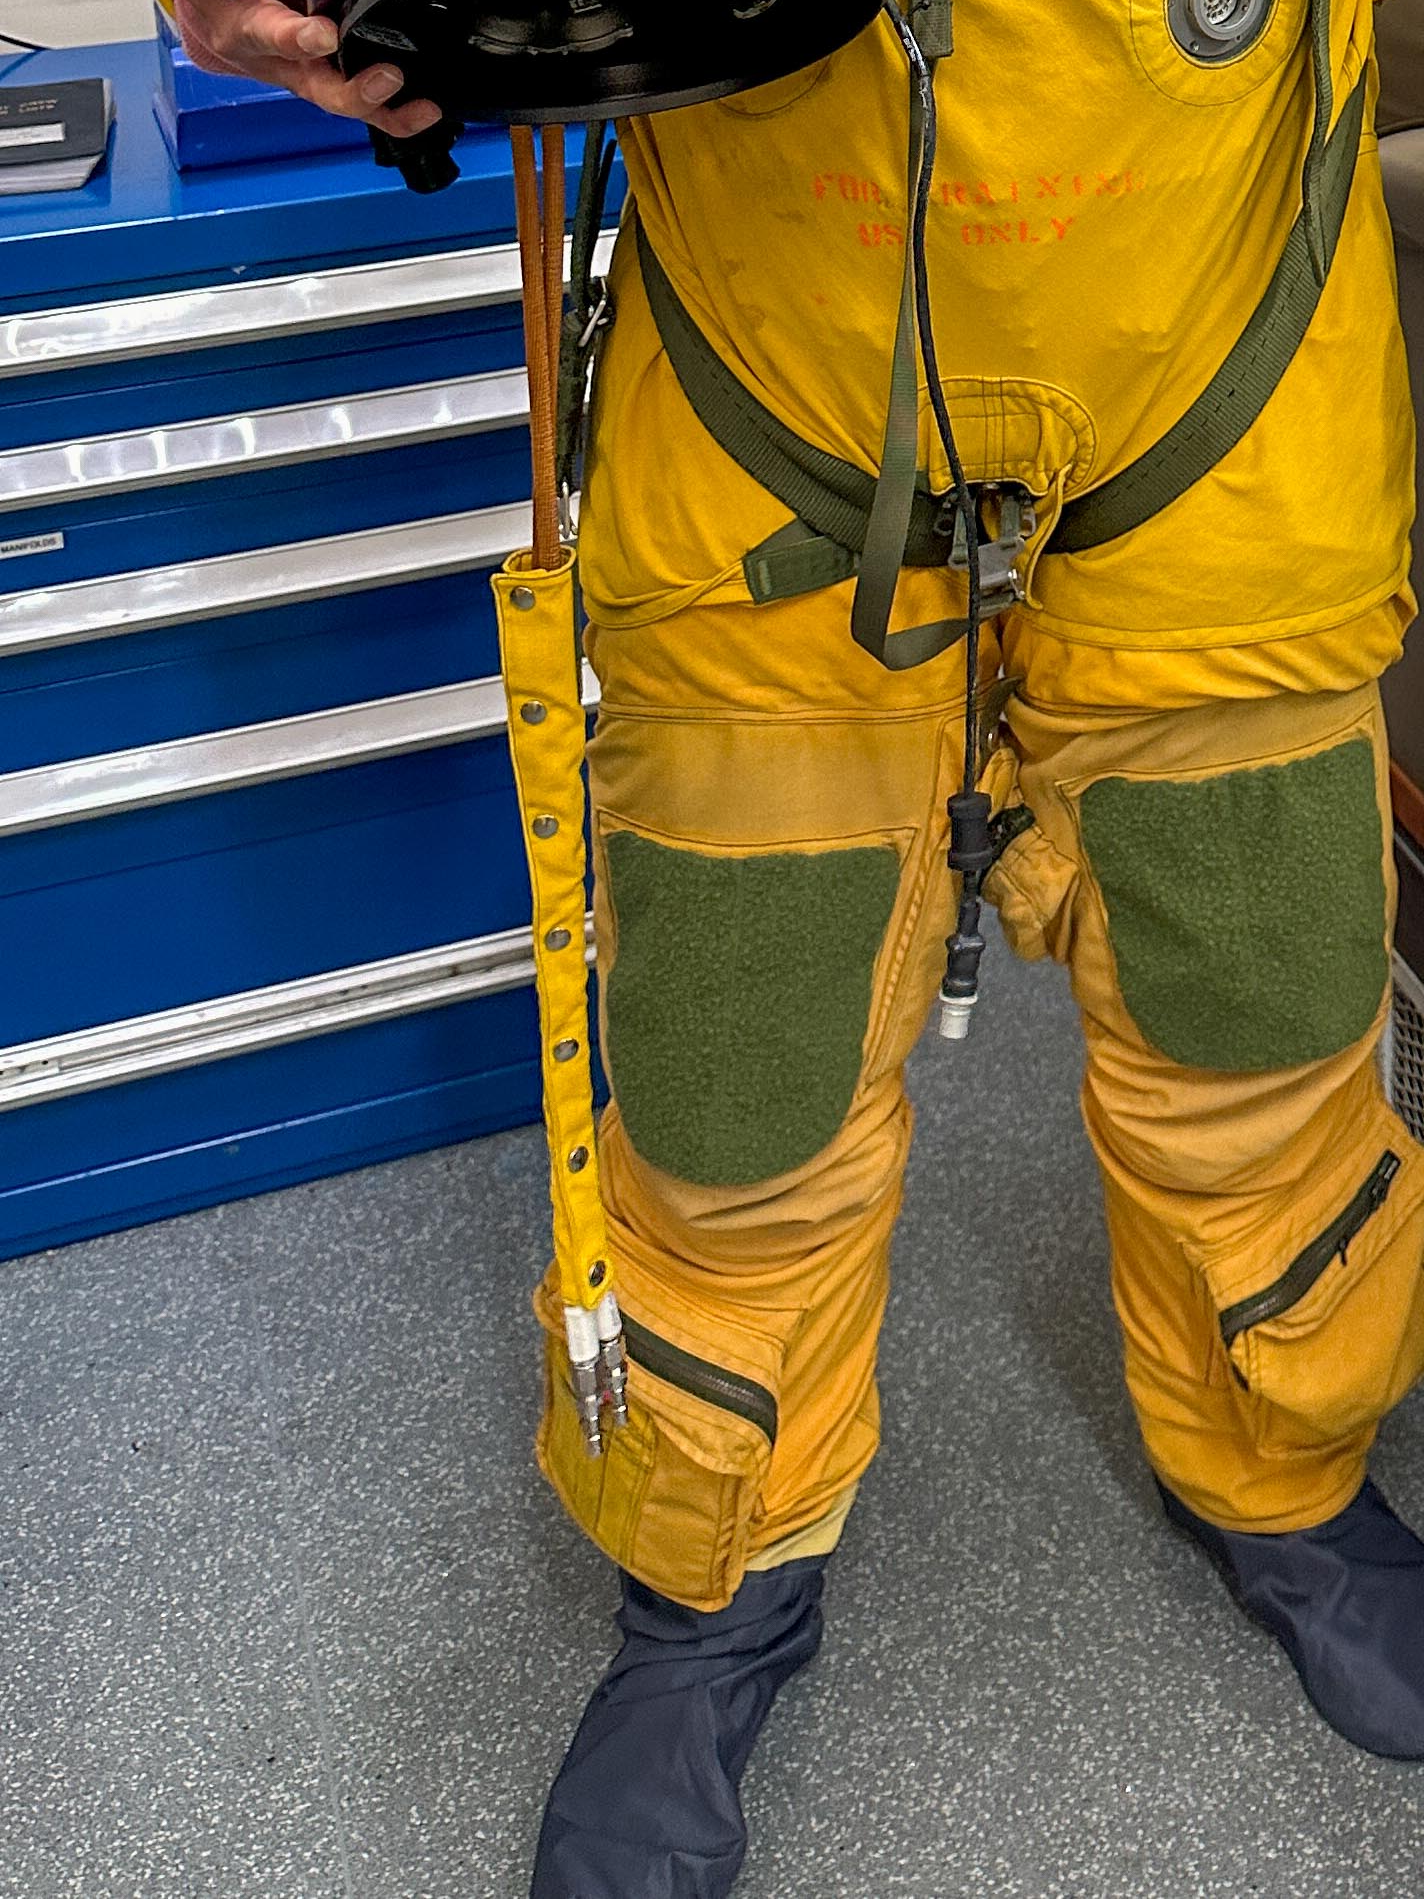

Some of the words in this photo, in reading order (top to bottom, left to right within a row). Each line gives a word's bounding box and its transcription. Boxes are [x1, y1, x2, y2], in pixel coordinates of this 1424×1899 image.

[813, 172, 881, 204] FOR
[939, 171, 1147, 207] RAINING
[857, 222, 905, 248] US
[960, 216, 1075, 247] ONLY
